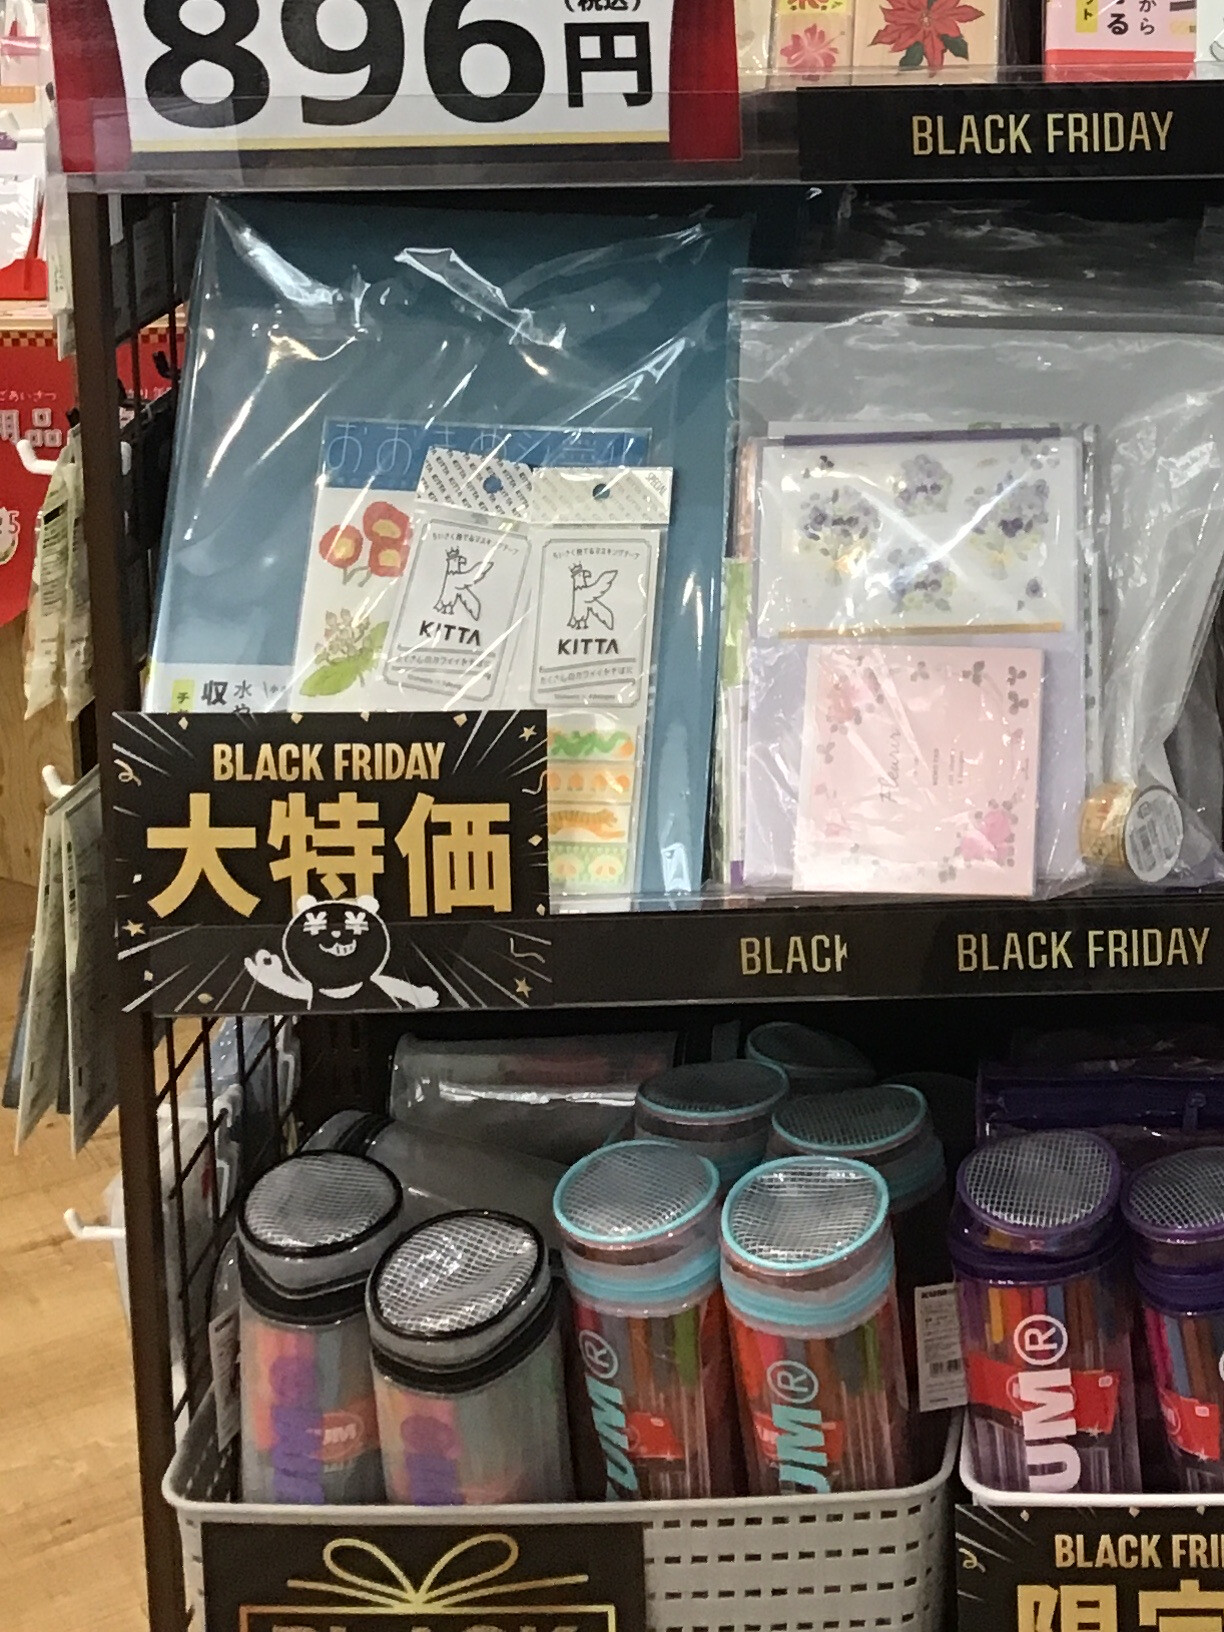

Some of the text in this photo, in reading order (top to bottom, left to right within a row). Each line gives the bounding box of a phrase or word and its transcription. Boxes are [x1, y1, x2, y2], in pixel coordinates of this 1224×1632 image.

[912, 111, 1174, 156] BLACK FRIDAY
[419, 619, 481, 646] KITTA
[558, 638, 619, 655] KITTA
[213, 741, 446, 782] BLACK FRIDAY
[146, 791, 512, 918] 大特価
[957, 927, 1210, 972] BLACK FRIDAY
[1054, 1533, 1161, 1568] BLACK
